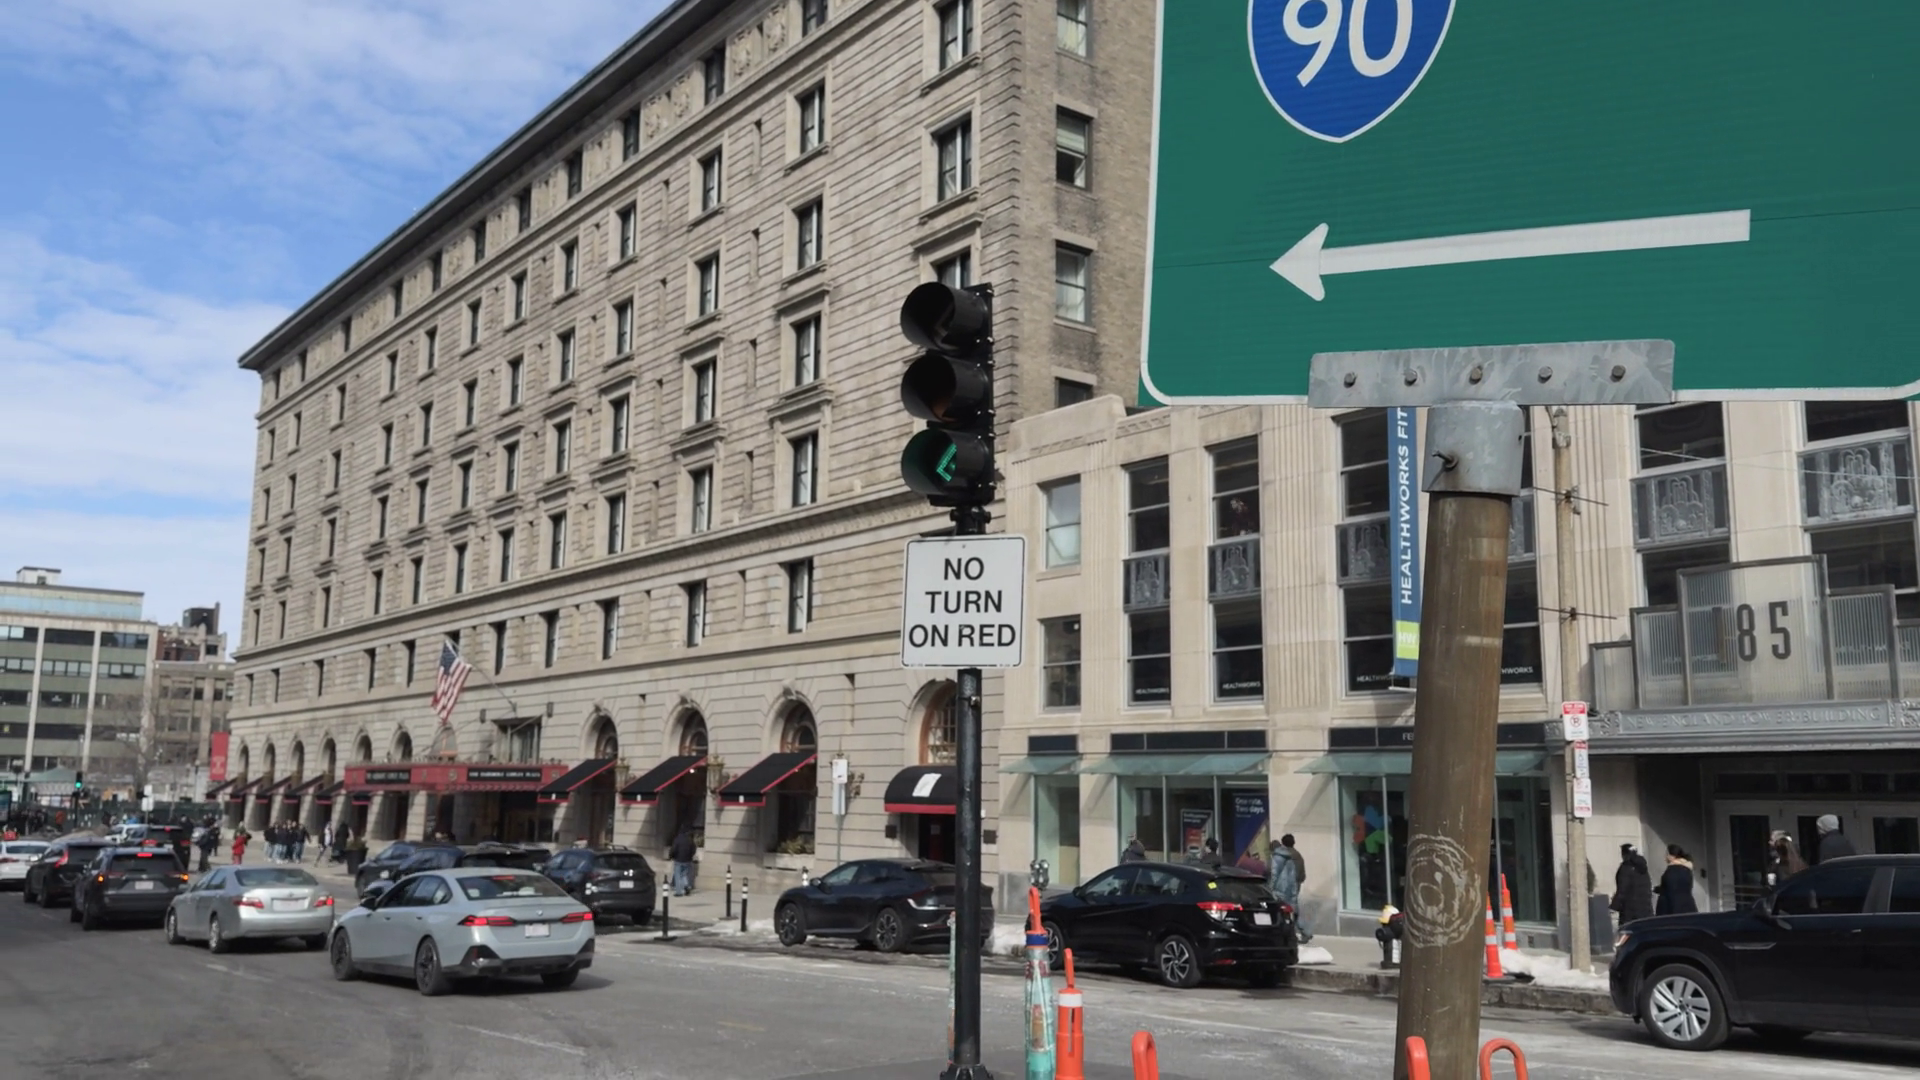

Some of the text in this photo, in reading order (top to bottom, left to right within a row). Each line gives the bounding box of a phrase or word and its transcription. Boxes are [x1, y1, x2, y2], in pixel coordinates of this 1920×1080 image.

[1282, 0, 1413, 88] 90
[1398, 445, 1413, 605] HEALTHWORKS
[944, 557, 984, 581] NO
[925, 590, 1002, 614] TURN
[909, 624, 1016, 648] ON RED
[1222, 681, 1262, 690] HEALTHWORKS
[1662, 713, 1733, 728] ENGLAND
[1741, 710, 1798, 725] POWER
[1802, 707, 1881, 724] BUILDING
